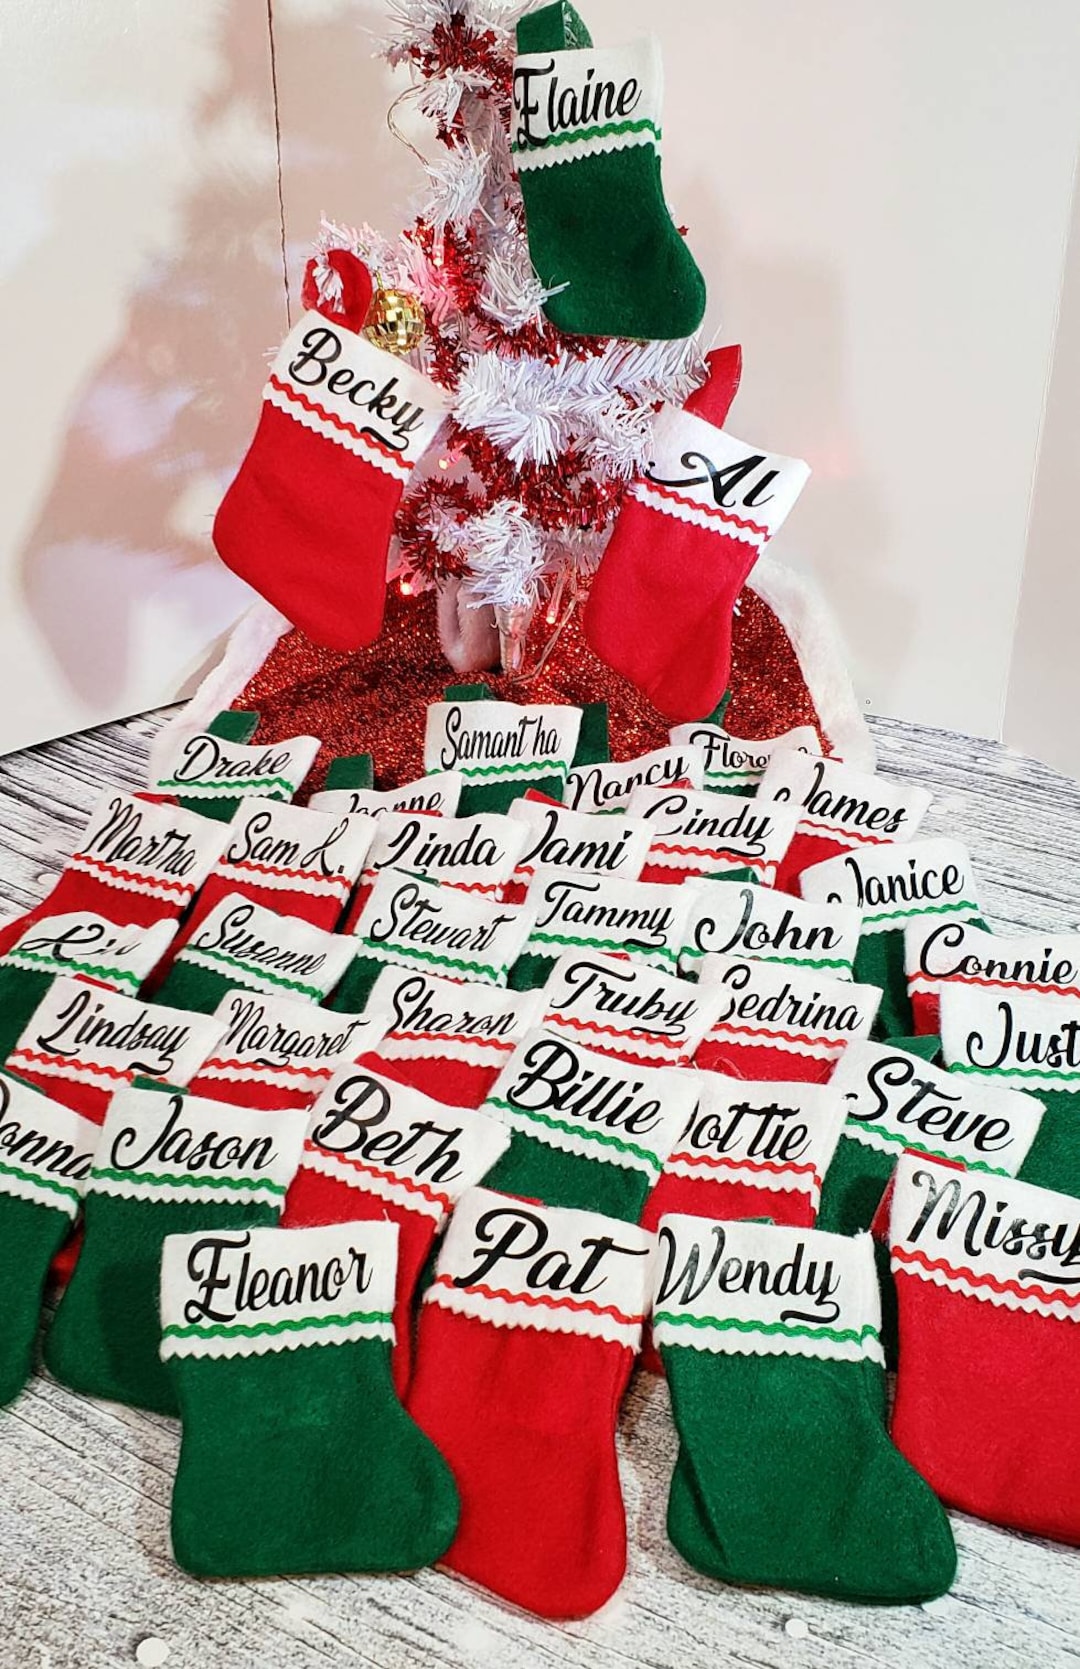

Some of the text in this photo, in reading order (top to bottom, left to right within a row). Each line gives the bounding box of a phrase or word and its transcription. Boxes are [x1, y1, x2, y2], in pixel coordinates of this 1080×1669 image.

[512, 58, 642, 150] Elaine
[288, 327, 424, 453] Becky
[643, 452, 780, 508] Al
[174, 735, 293, 783] Drake
[441, 706, 562, 770] Samantha
[566, 756, 690, 811] Nancy
[774, 762, 908, 833] James
[80, 798, 197, 877] Martha
[227, 812, 301, 864] Sam
[373, 820, 505, 875] Linda
[518, 810, 628, 871] Jami
[643, 795, 774, 858] Cindy
[535, 881, 677, 949] Tammy
[827, 857, 965, 907] Janice
[195, 904, 327, 976] Susanne
[370, 883, 516, 952] Stewart
[694, 889, 843, 955] John
[920, 923, 1079, 984] Connie
[390, 976, 519, 1037] Sharon
[550, 961, 699, 1036] Truby
[718, 964, 864, 1031] Sedrina
[37, 989, 190, 1076] Lindsay
[225, 998, 371, 1068] Margaret
[506, 1039, 665, 1134] Billie
[843, 1056, 1014, 1152] Steve
[111, 1095, 278, 1171] Jason
[312, 1075, 463, 1184] Beth
[678, 1099, 812, 1161] ottie
[184, 1231, 373, 1323] Eleanor
[453, 1208, 650, 1294] Pat
[655, 1226, 840, 1324] Wendy
